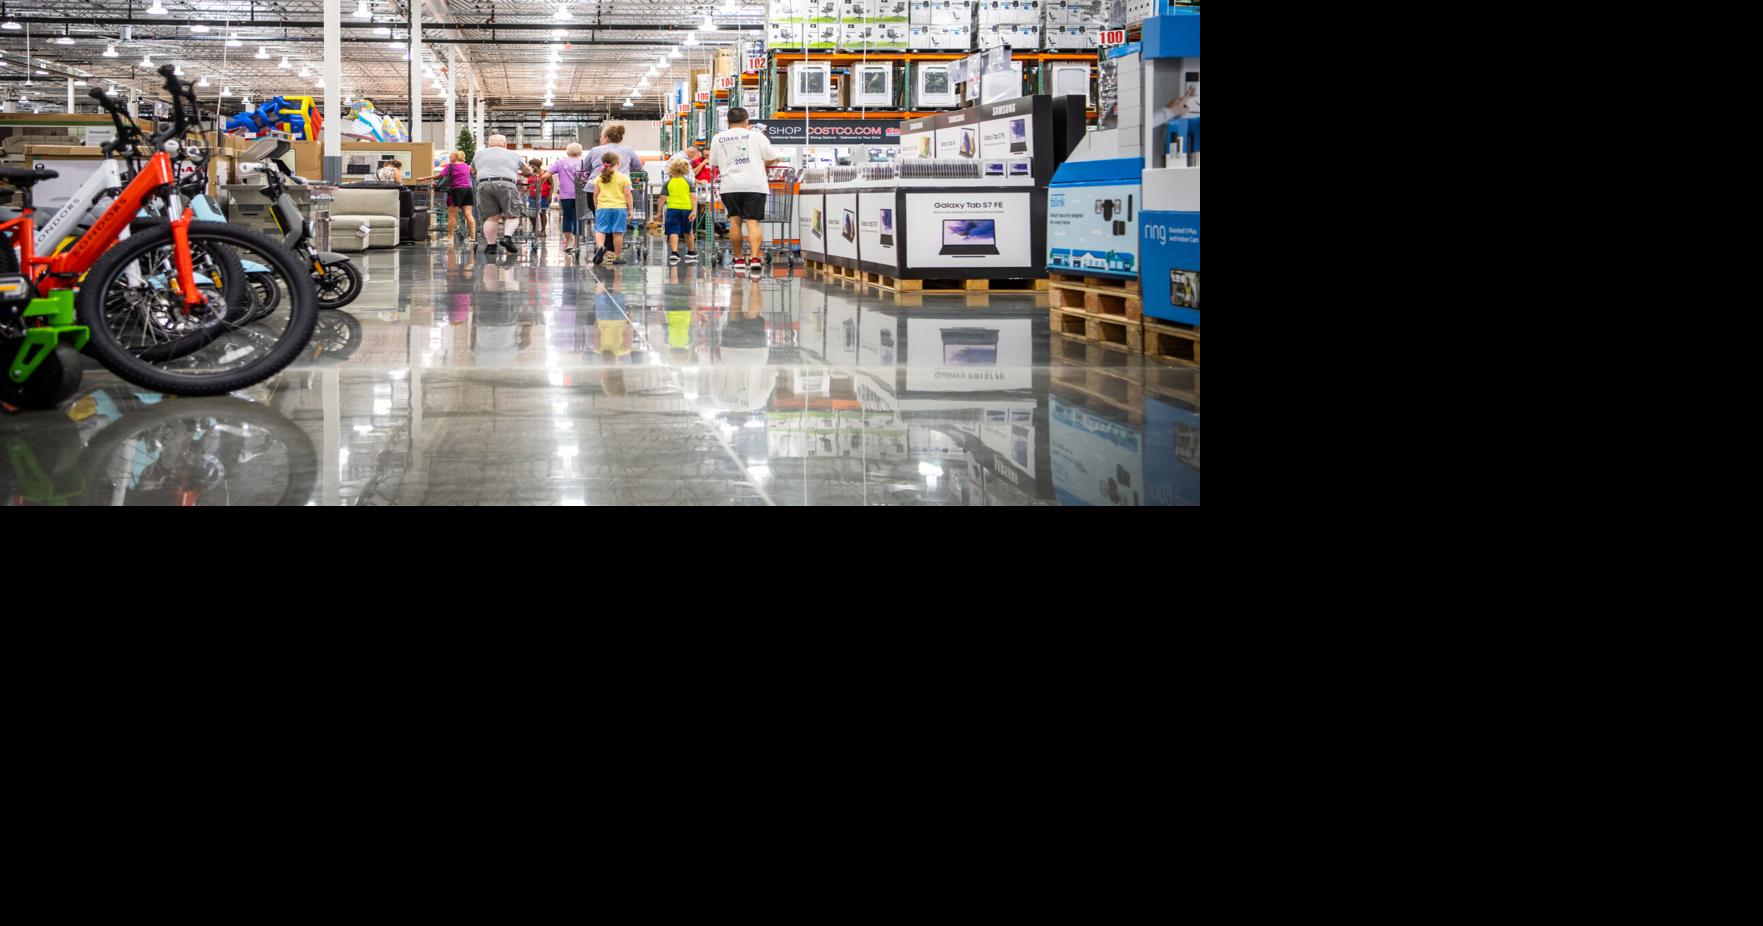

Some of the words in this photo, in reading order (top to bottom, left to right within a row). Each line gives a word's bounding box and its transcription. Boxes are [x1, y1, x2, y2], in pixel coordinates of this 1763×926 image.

[1101, 31, 1123, 45] 100
[749, 58, 766, 69] 102
[721, 78, 734, 88] 104
[992, 103, 1016, 117] SAMSUNG
[769, 126, 802, 135] SHOP
[806, 126, 882, 135] COSTCO.COM
[934, 201, 965, 210] Galaxy
[1144, 223, 1166, 246] ring
